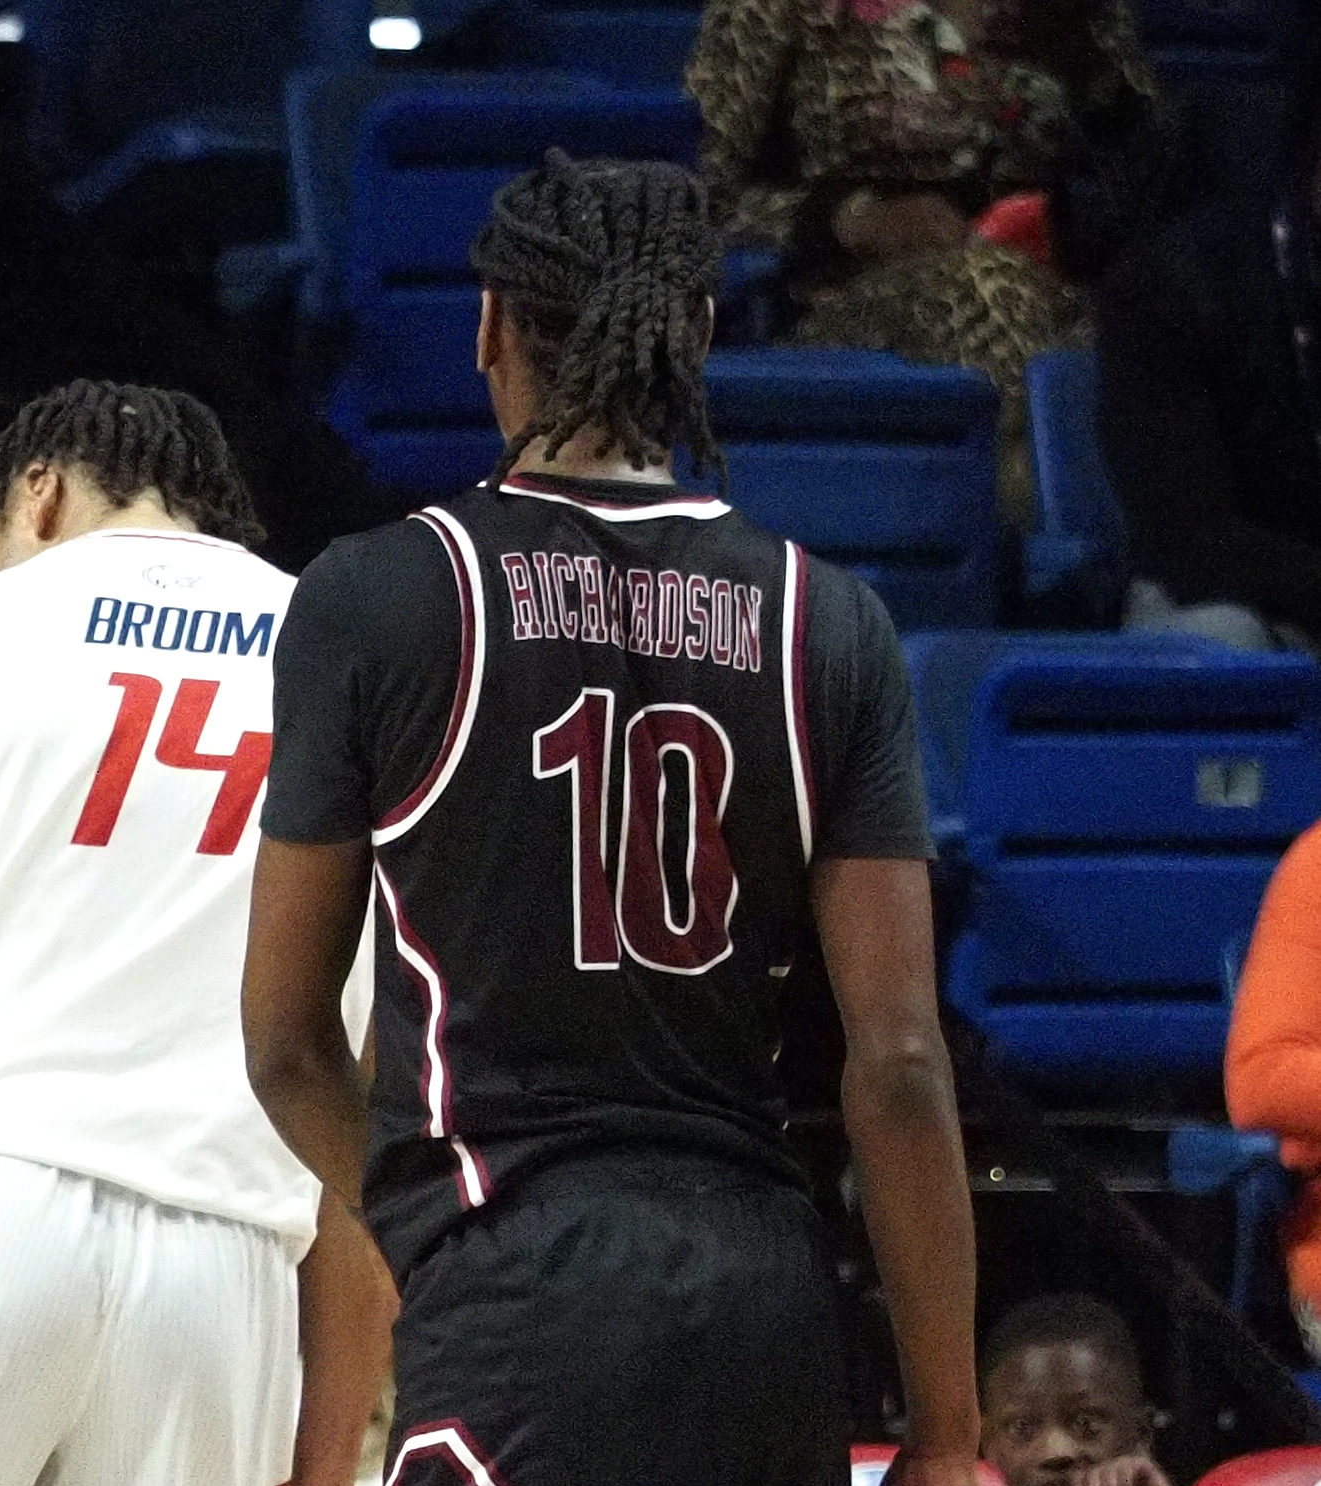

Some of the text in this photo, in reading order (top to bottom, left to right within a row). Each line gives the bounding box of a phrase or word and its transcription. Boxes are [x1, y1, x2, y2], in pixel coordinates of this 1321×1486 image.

[84, 596, 276, 658] BROOM
[501, 552, 761, 672] RICHARDSON
[69, 671, 275, 857] 14
[532, 687, 740, 976] 10
